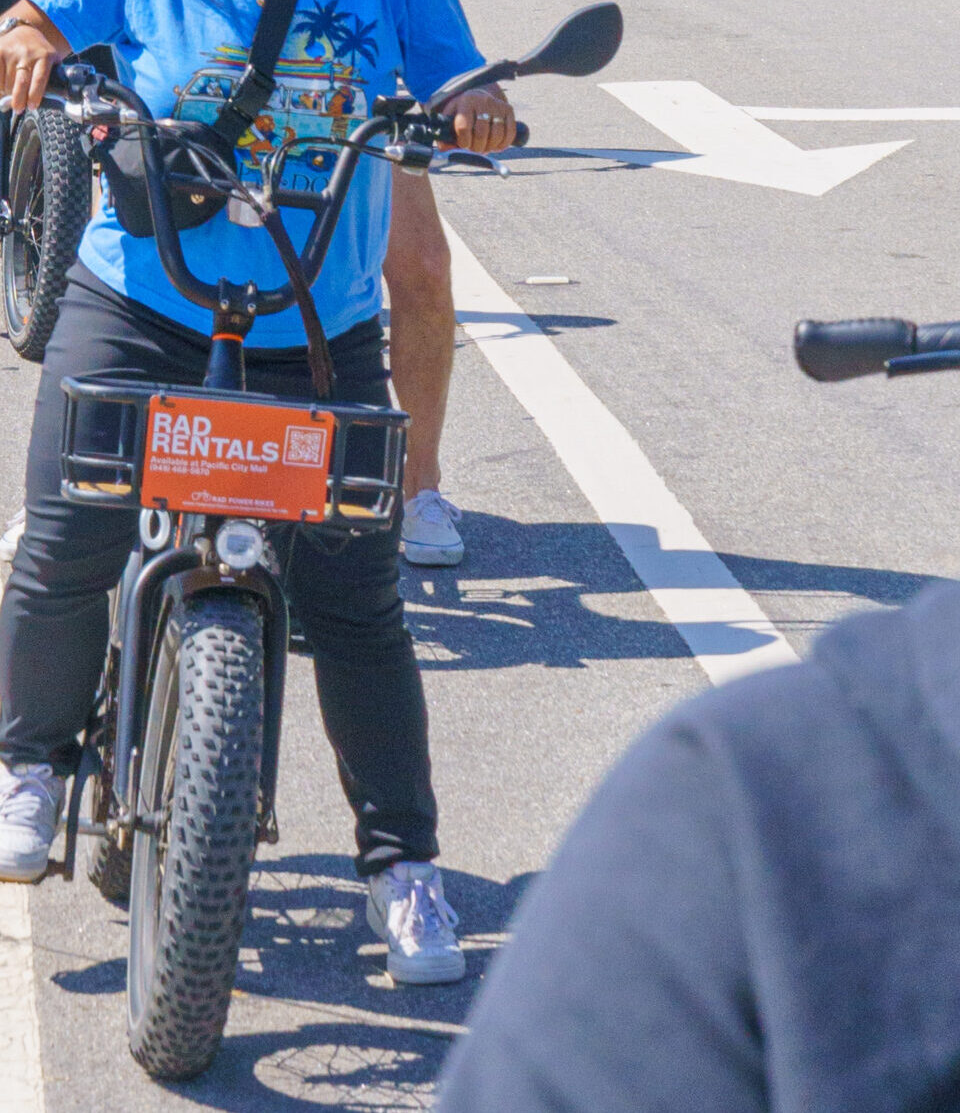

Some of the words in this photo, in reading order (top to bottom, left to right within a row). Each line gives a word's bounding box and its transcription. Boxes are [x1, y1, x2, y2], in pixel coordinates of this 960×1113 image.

[153, 412, 212, 437] RAD
[151, 435, 280, 463] RENTALS
[150, 456, 188, 466] Available
[201, 460, 229, 470] Pacific
[231, 462, 248, 473] City
[250, 464, 268, 473] Mall
